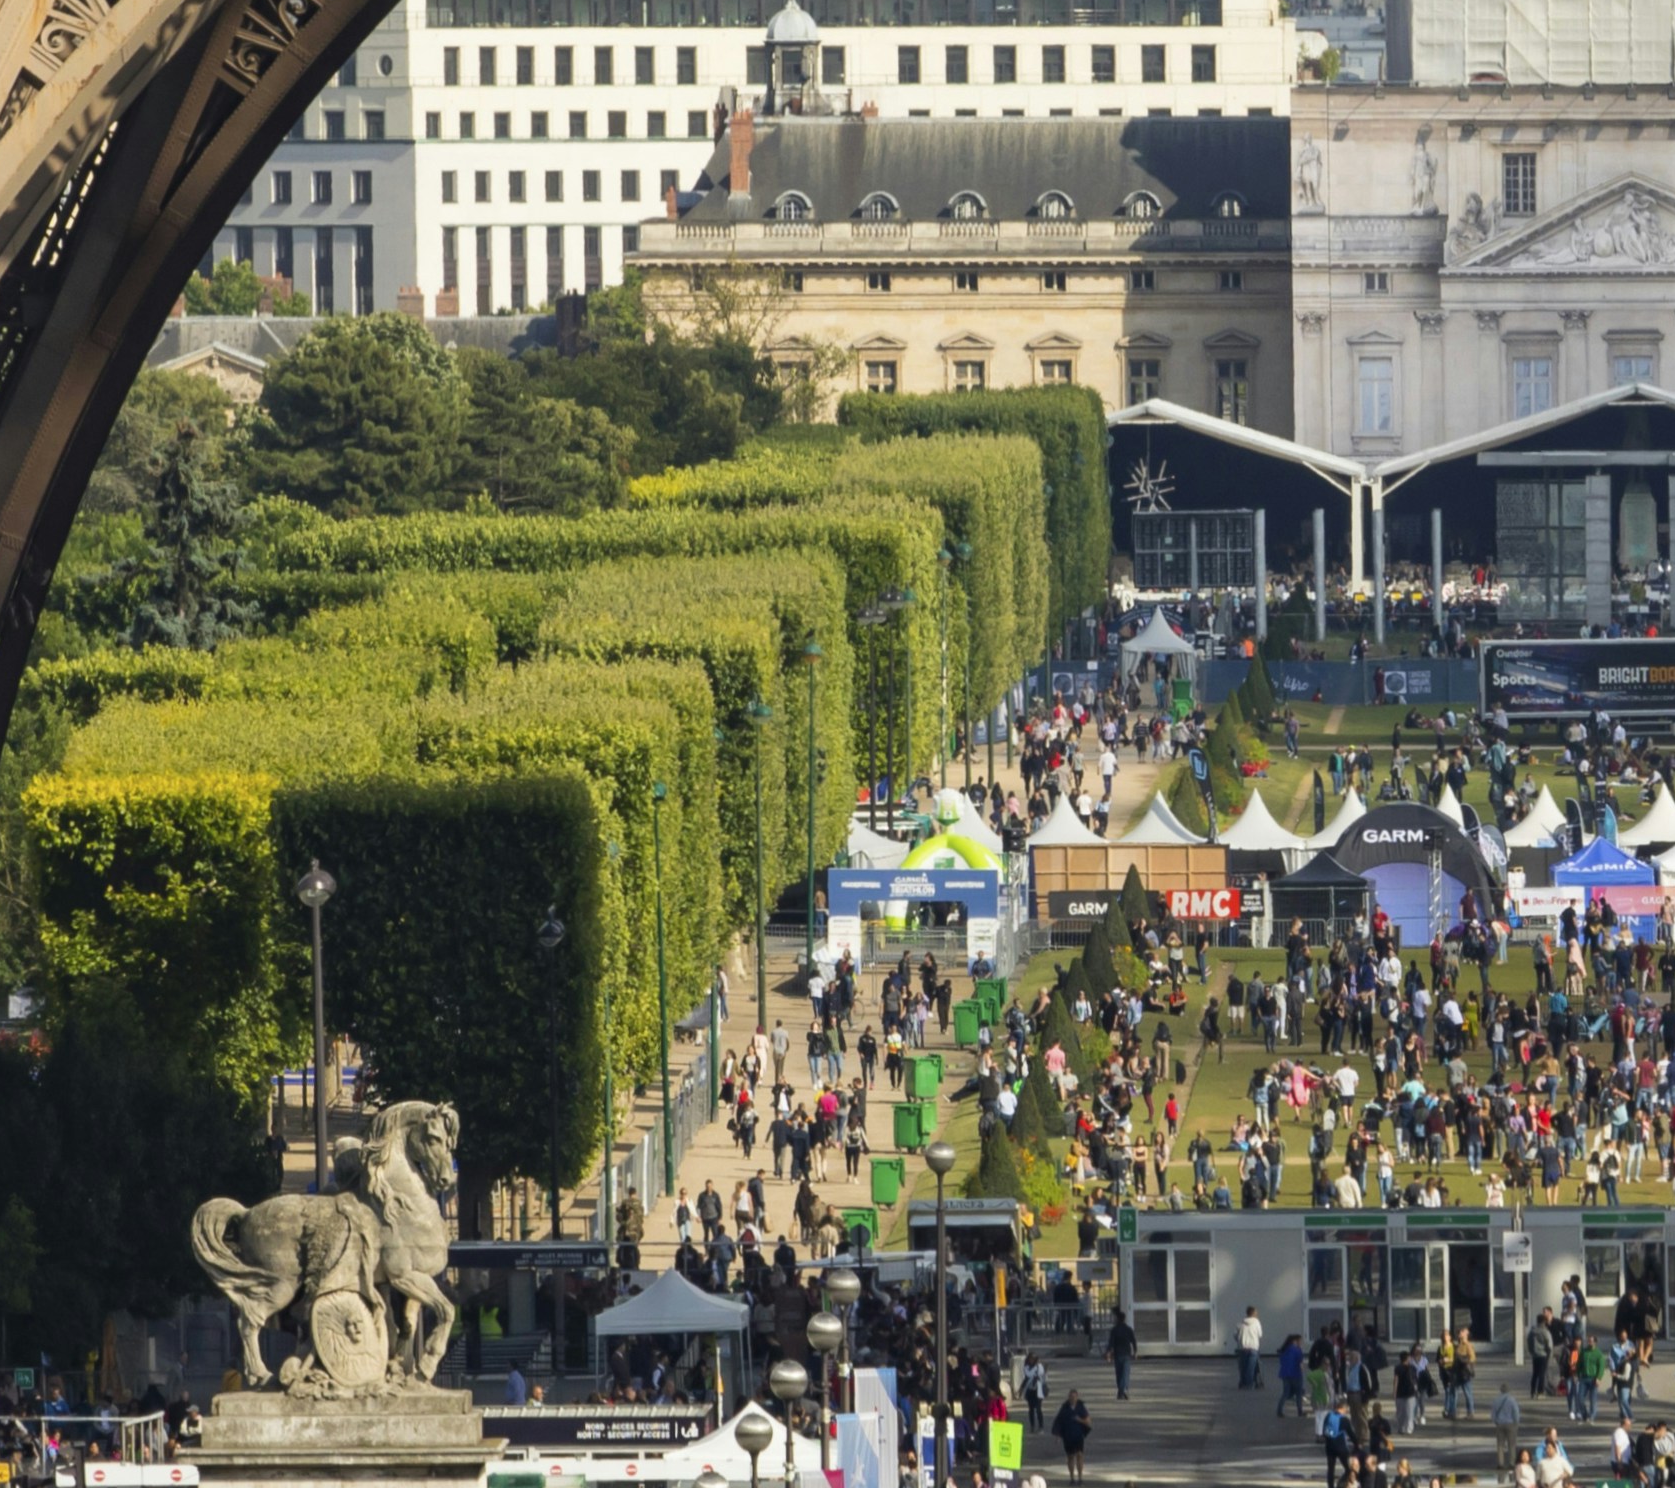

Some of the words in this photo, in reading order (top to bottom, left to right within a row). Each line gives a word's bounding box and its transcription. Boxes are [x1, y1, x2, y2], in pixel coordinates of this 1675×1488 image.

[1493, 673, 1537, 688] Sports
[1363, 829, 1423, 843] GARM
[1068, 902, 1108, 915] GARM
[1172, 890, 1231, 917] RMC
